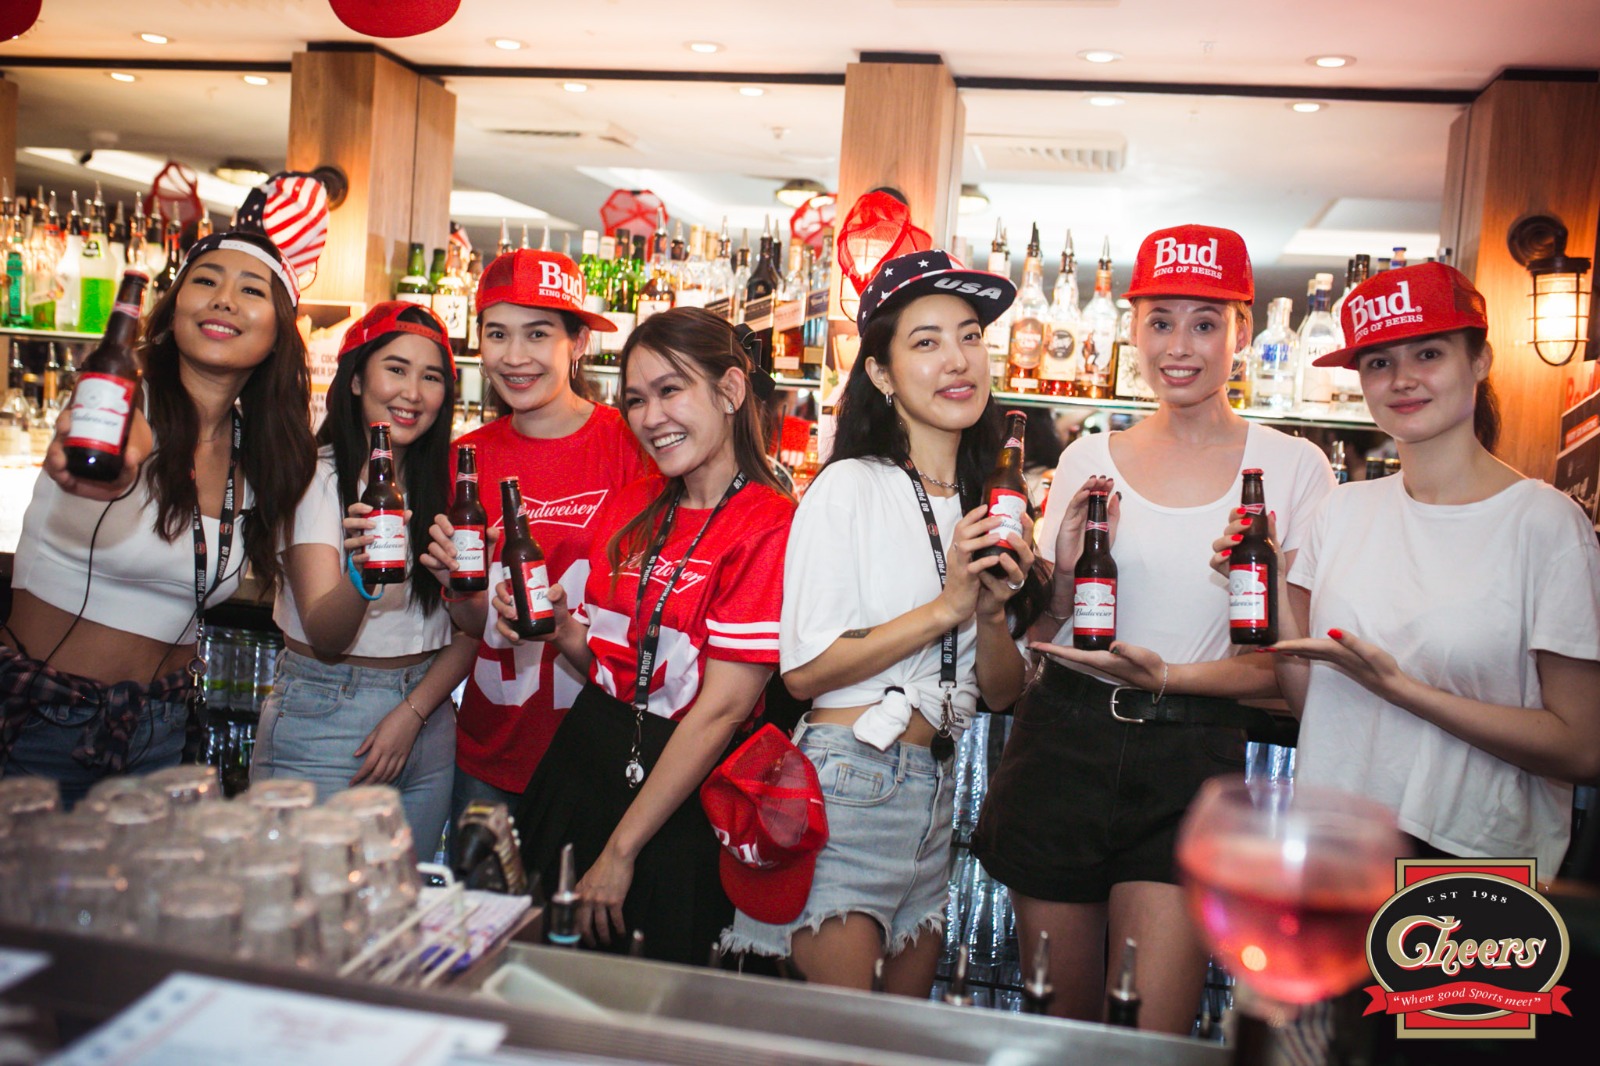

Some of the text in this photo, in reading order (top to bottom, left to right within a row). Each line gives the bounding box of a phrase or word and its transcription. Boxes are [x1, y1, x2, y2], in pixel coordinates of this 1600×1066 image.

[538, 260, 583, 304] Bud
[1176, 265, 1190, 273] OF
[1191, 266, 1222, 280] BEERS
[538, 288, 561, 299] KING
[933, 277, 1002, 300] USA
[1370, 322, 1383, 332] OF
[1385, 314, 1424, 328] BEERS
[732, 478, 744, 490] 80
[222, 487, 234, 511] PROOF
[913, 480, 931, 513] 80 PROOF
[525, 500, 598, 520] udweiser
[221, 545, 230, 556] 80
[648, 555, 658, 565] 80
[934, 549, 947, 574] PROOF
[196, 568, 206, 592] PROOF
[654, 580, 674, 612] 80 PROOF
[1074, 607, 1113, 617] Budweiser
[638, 650, 653, 687] 80 PROOF
[943, 653, 953, 664] 80
